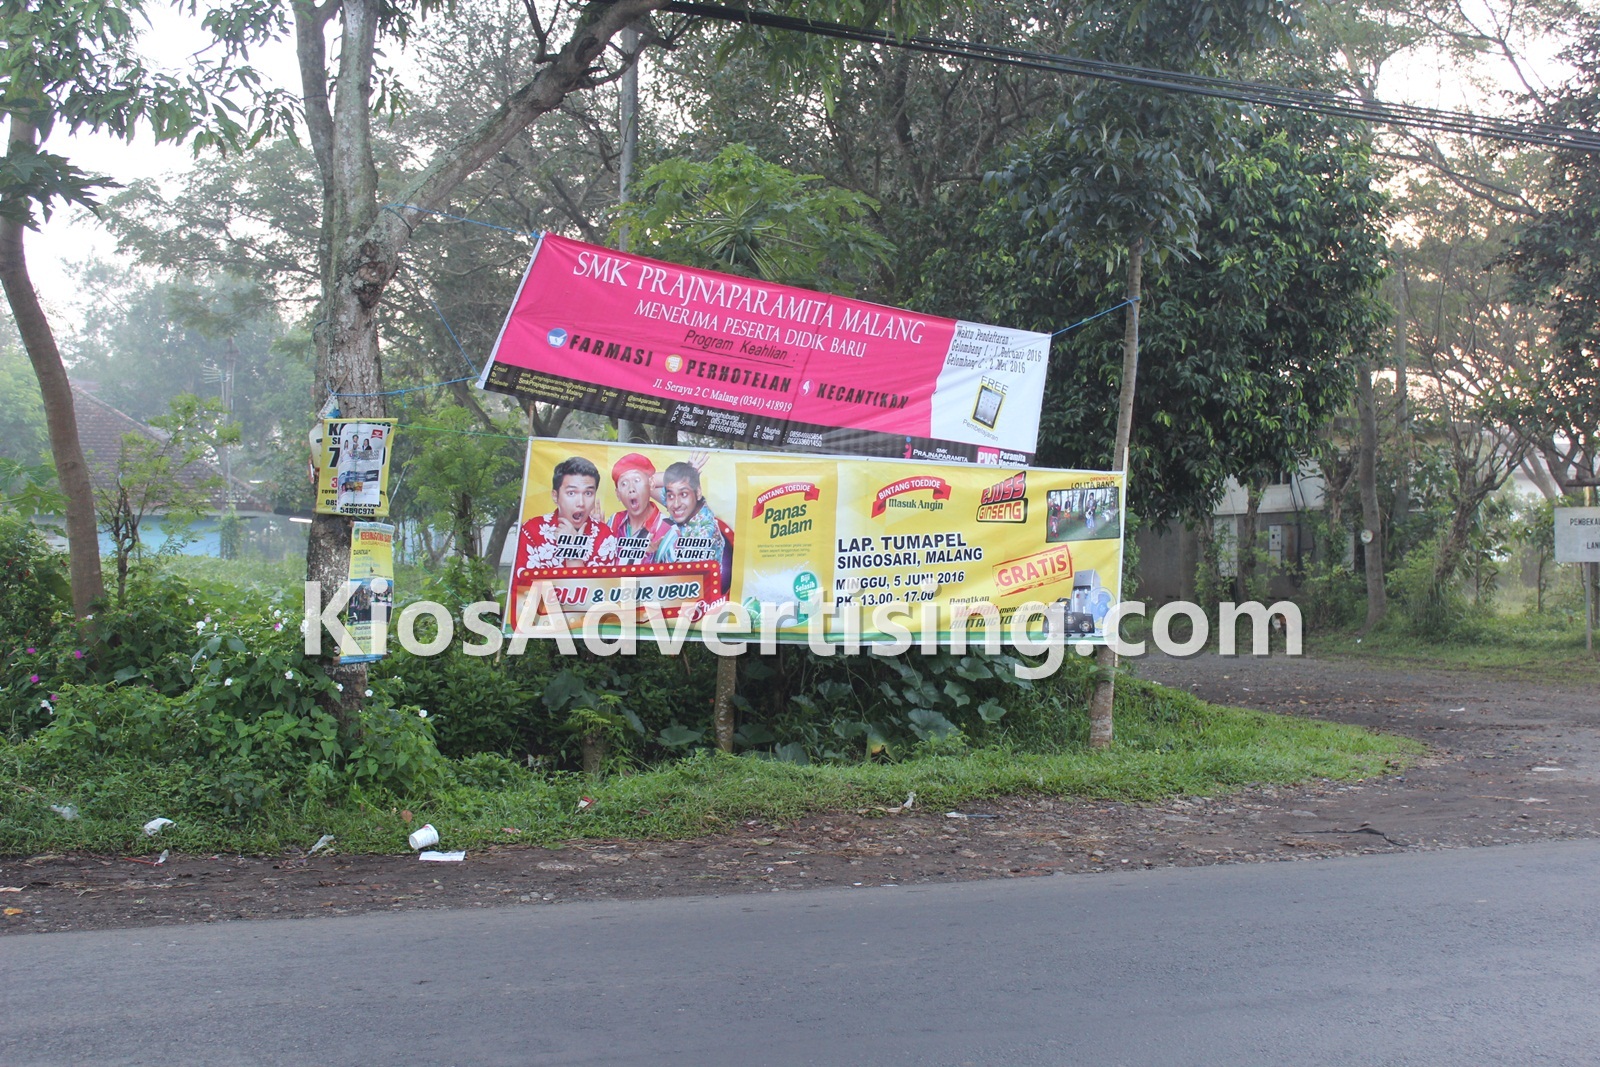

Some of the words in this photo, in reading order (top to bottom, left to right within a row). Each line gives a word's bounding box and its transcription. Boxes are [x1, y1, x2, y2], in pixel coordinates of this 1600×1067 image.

[573, 251, 631, 287] SMK
[637, 264, 833, 328] PRAJNAPARAMITA
[838, 307, 926, 344] MALANG
[634, 299, 718, 332] MENERIMA
[723, 316, 780, 343] PESERTA
[784, 328, 825, 351] DIDIK
[829, 337, 867, 357] BARU
[957, 325, 974, 339] Waktu
[975, 328, 1009, 345] Pendaftaran
[684, 330, 734, 351] Program
[739, 340, 788, 361] Keahlian
[951, 339, 982, 357] Gelombang
[1027, 349, 1042, 362] 2016
[569, 334, 653, 367] FARMASI
[685, 359, 792, 393] PERHOTELAN
[817, 382, 909, 409] KECANTIKAN
[946, 353, 978, 370] Gelombang
[1010, 360, 1026, 373] 2016
[981, 375, 1009, 395] FREE
[653, 378, 663, 389] Jl.
[664, 381, 693, 396] Serayu
[694, 386, 701, 396] 2
[702, 388, 709, 398] C
[709, 390, 739, 406] Malang
[739, 395, 765, 410] (0341)
[765, 398, 793, 413] 418919
[676, 404, 690, 413] Anda
[692, 407, 704, 415] Bisa
[963, 419, 998, 441] Pembelajaran
[913, 449, 968, 463] PRAJNAPARAMITA
[977, 452, 998, 465] PVS
[1000, 451, 1026, 462] Paramita
[757, 487, 784, 504] BINTANG
[878, 481, 910, 500] BINTANG
[911, 479, 941, 489] TOEDJOE
[764, 504, 807, 524] Panas
[918, 499, 943, 511] Angin
[770, 519, 812, 539] Dalam
[1570, 518, 1600, 526] PEMBEKA
[557, 535, 588, 546] ALDI
[618, 538, 649, 548] BANG
[677, 537, 714, 548] BOBBY
[838, 537, 875, 553] LAP.
[880, 533, 967, 551] TUMAPEL
[1587, 542, 1600, 550] LAN
[837, 552, 921, 569] SINGOSARI,
[925, 548, 983, 564] MALANG
[893, 575, 901, 586] 5
[937, 571, 965, 584] 2016
[997, 554, 1067, 587] GRATIS
[547, 586, 588, 604] BIJI
[592, 589, 604, 602] &
[610, 587, 653, 601] UBUR
[658, 583, 699, 599] UBUR
[861, 592, 893, 607] 13.00
[904, 591, 934, 603] 17.00
[687, 596, 727, 621] Show
